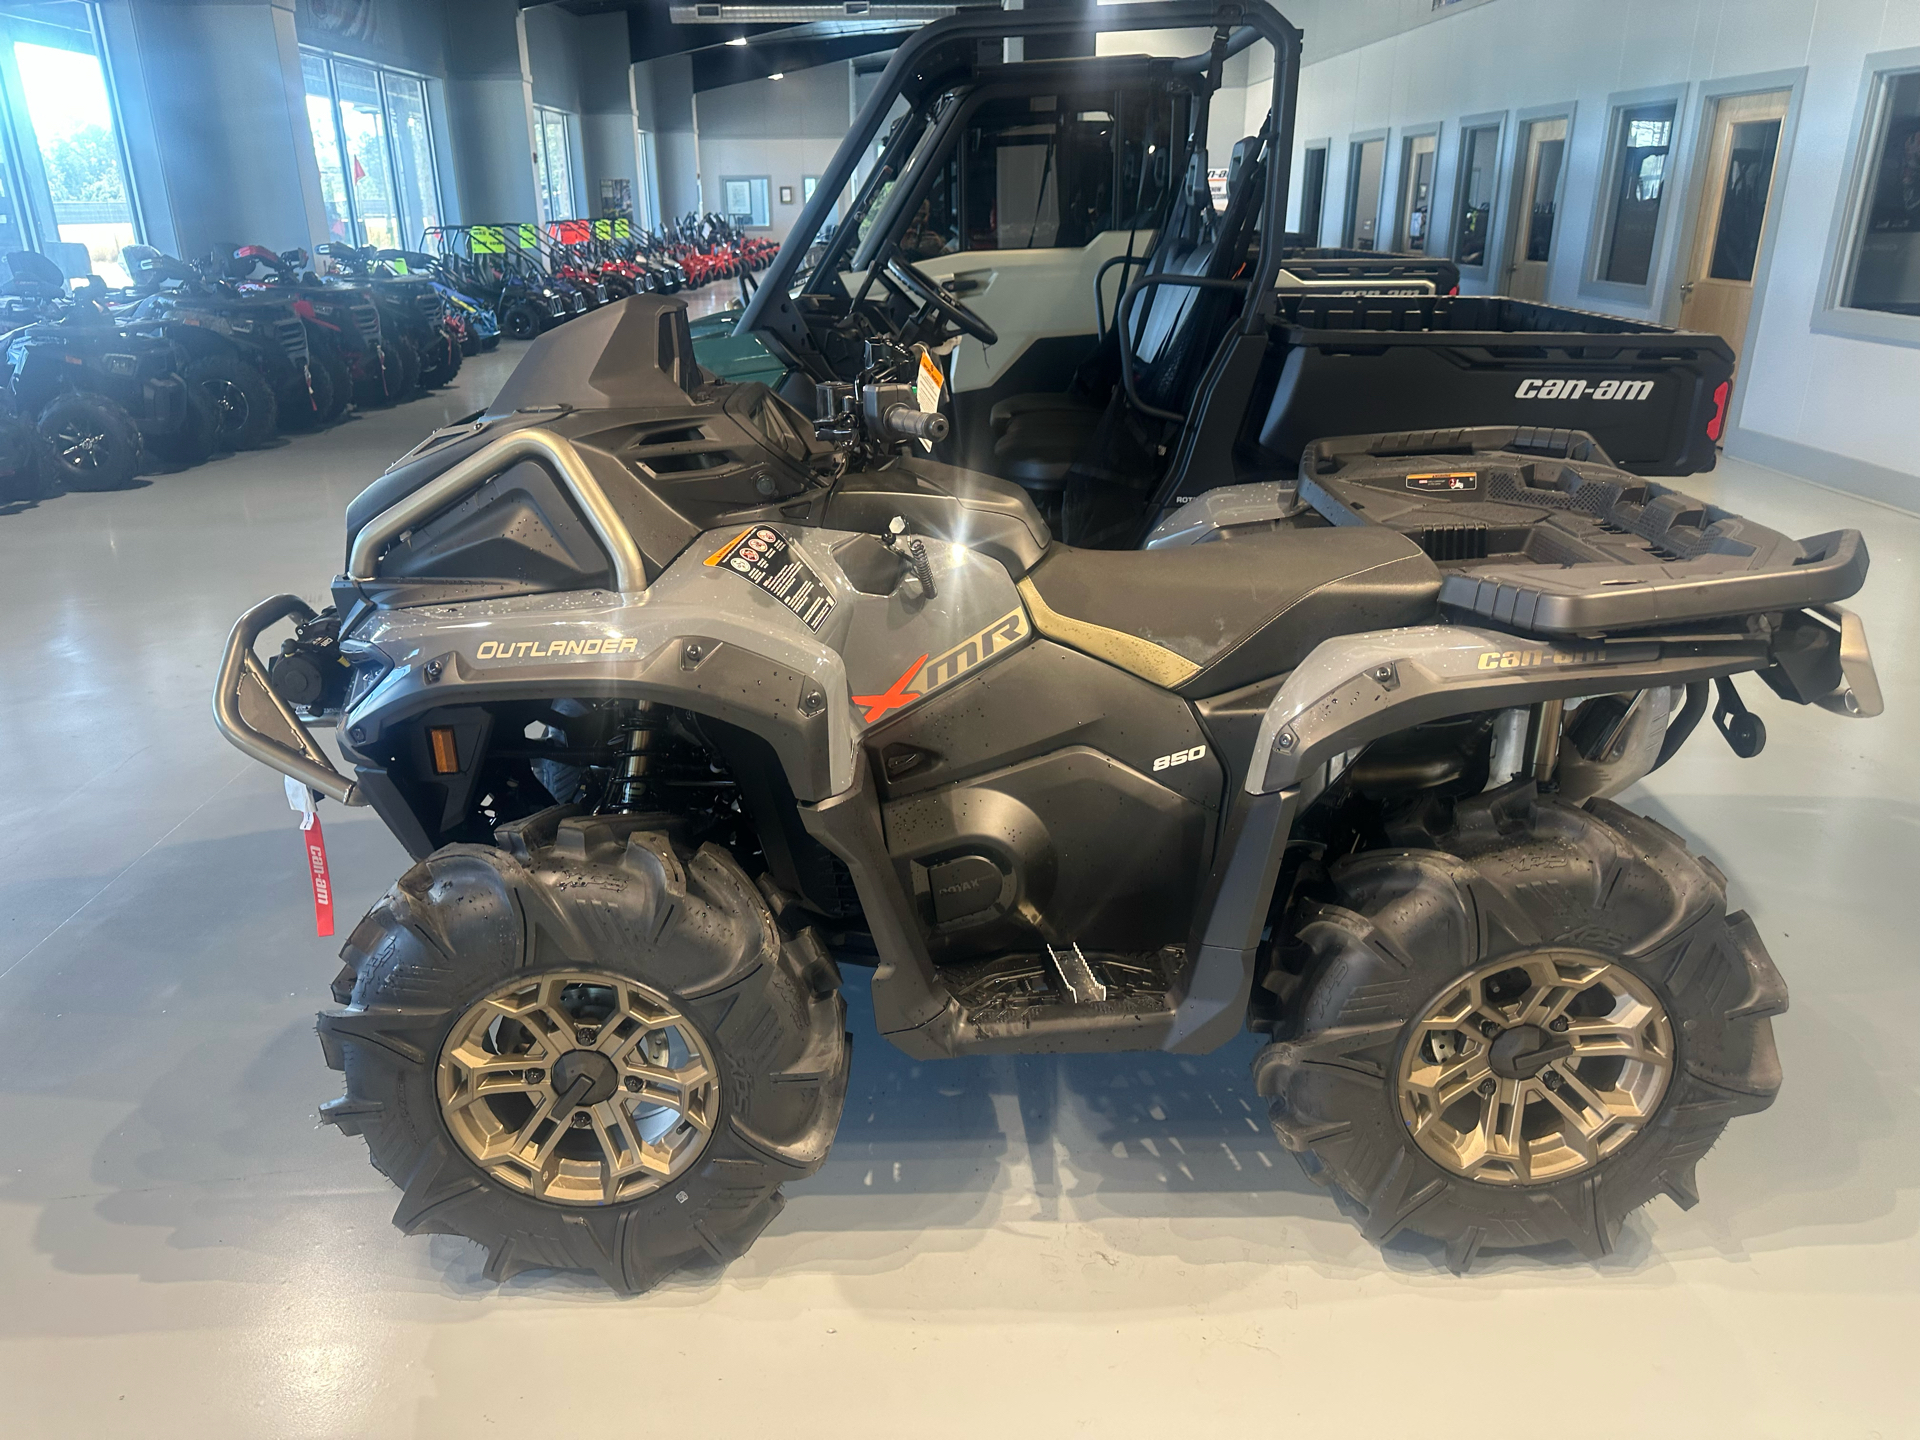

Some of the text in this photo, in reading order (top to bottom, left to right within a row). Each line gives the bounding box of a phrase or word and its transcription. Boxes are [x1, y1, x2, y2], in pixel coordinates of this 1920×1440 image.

[1514, 378, 1655, 400] can-am
[1176, 496, 1194, 504] ROT
[476, 638, 638, 660] OUTLANDER
[1153, 745, 1206, 771] 850
[310, 845, 329, 905] can-am
